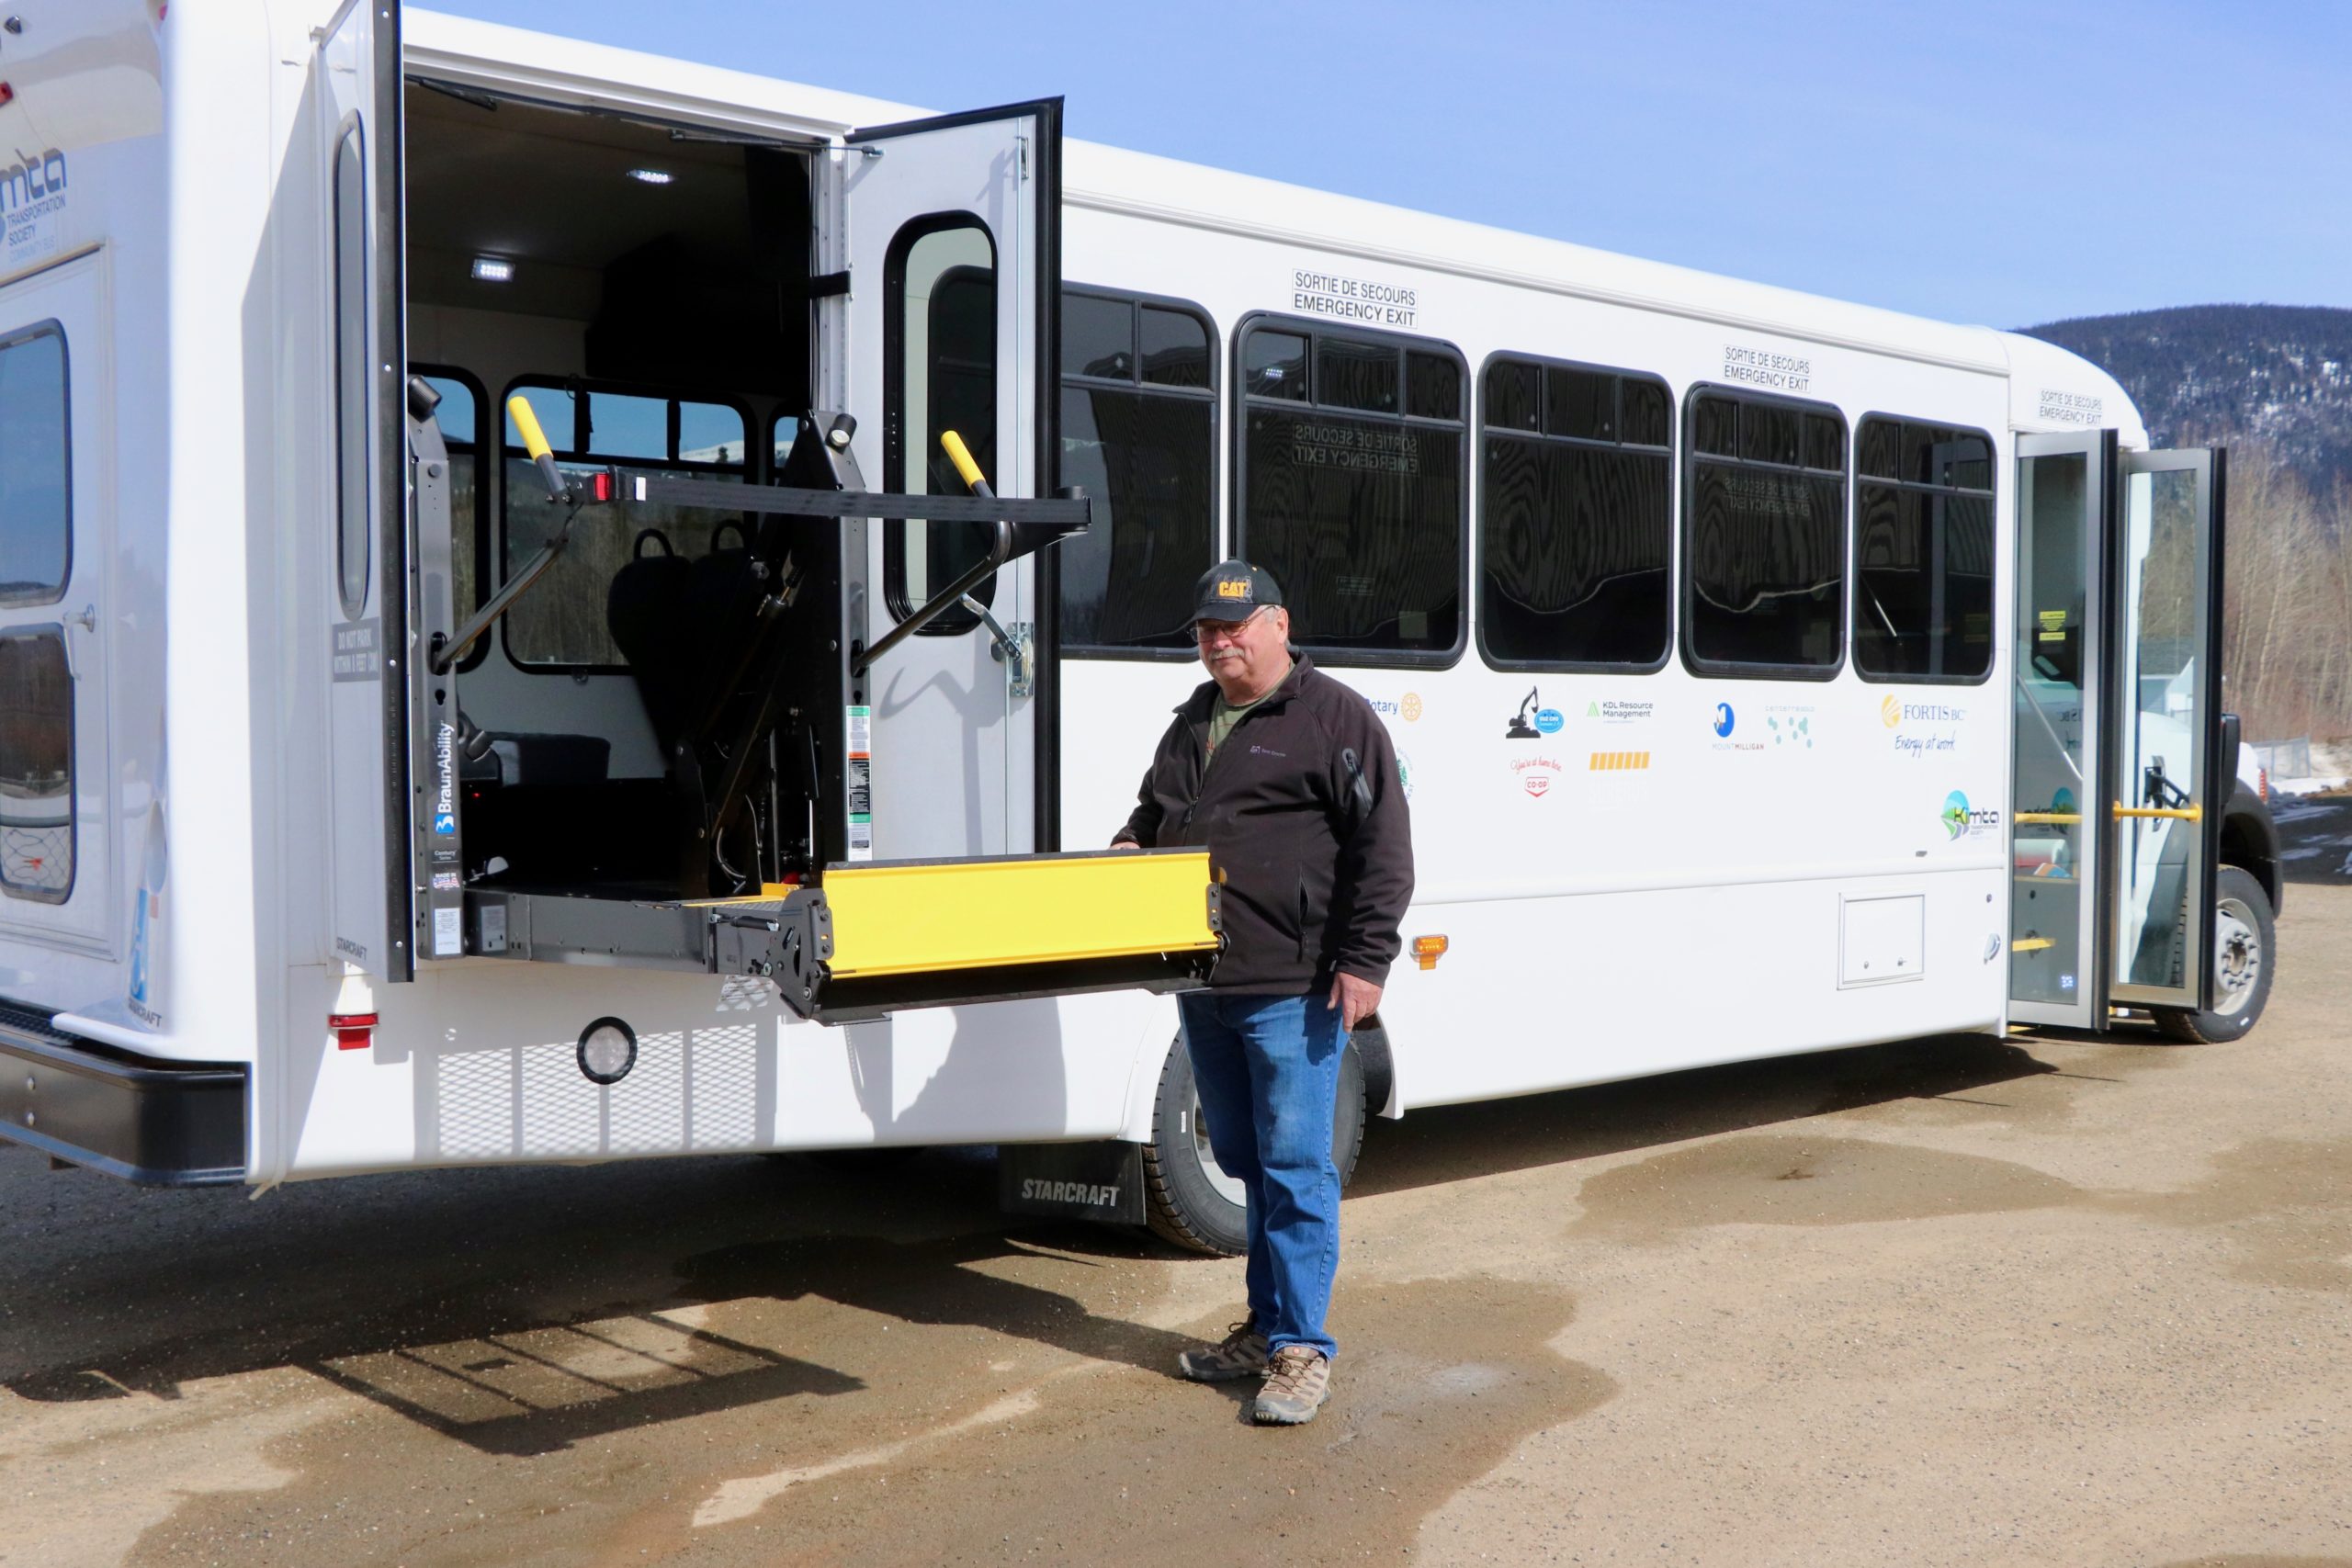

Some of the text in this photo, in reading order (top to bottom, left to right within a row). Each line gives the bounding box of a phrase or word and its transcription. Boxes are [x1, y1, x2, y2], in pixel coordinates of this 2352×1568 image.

[7, 194, 66, 228] TRANSPORTATION
[9, 224, 36, 247] SOCIETY
[1295, 272, 1416, 306] SORTIE DE SECOURS
[1295, 293, 1416, 326] EMERGENCY EXIT
[1725, 346, 1810, 375] SORTIE DE SECOURS
[1724, 365, 1809, 391] EMERGENCY EXIT
[2041, 389, 2064, 405] SORTIE
[2064, 393, 2073, 406] DE
[2040, 405, 2102, 424] EMERGENCY EXIT
[1217, 581, 1247, 598] CAT
[1365, 699, 1398, 715] otary
[1603, 701, 1654, 709] KDL Resource
[1603, 709, 1652, 719] Management
[1904, 705, 1950, 721] FORTIS
[1894, 730, 1956, 759] Energy at work
[437, 722, 456, 814] BraunAbility
[1953, 807, 2000, 825] Kimta
[435, 850, 456, 858] Century
[336, 936, 368, 961] STARCRAFT
[1021, 1178, 1121, 1207] STARCRAFT
